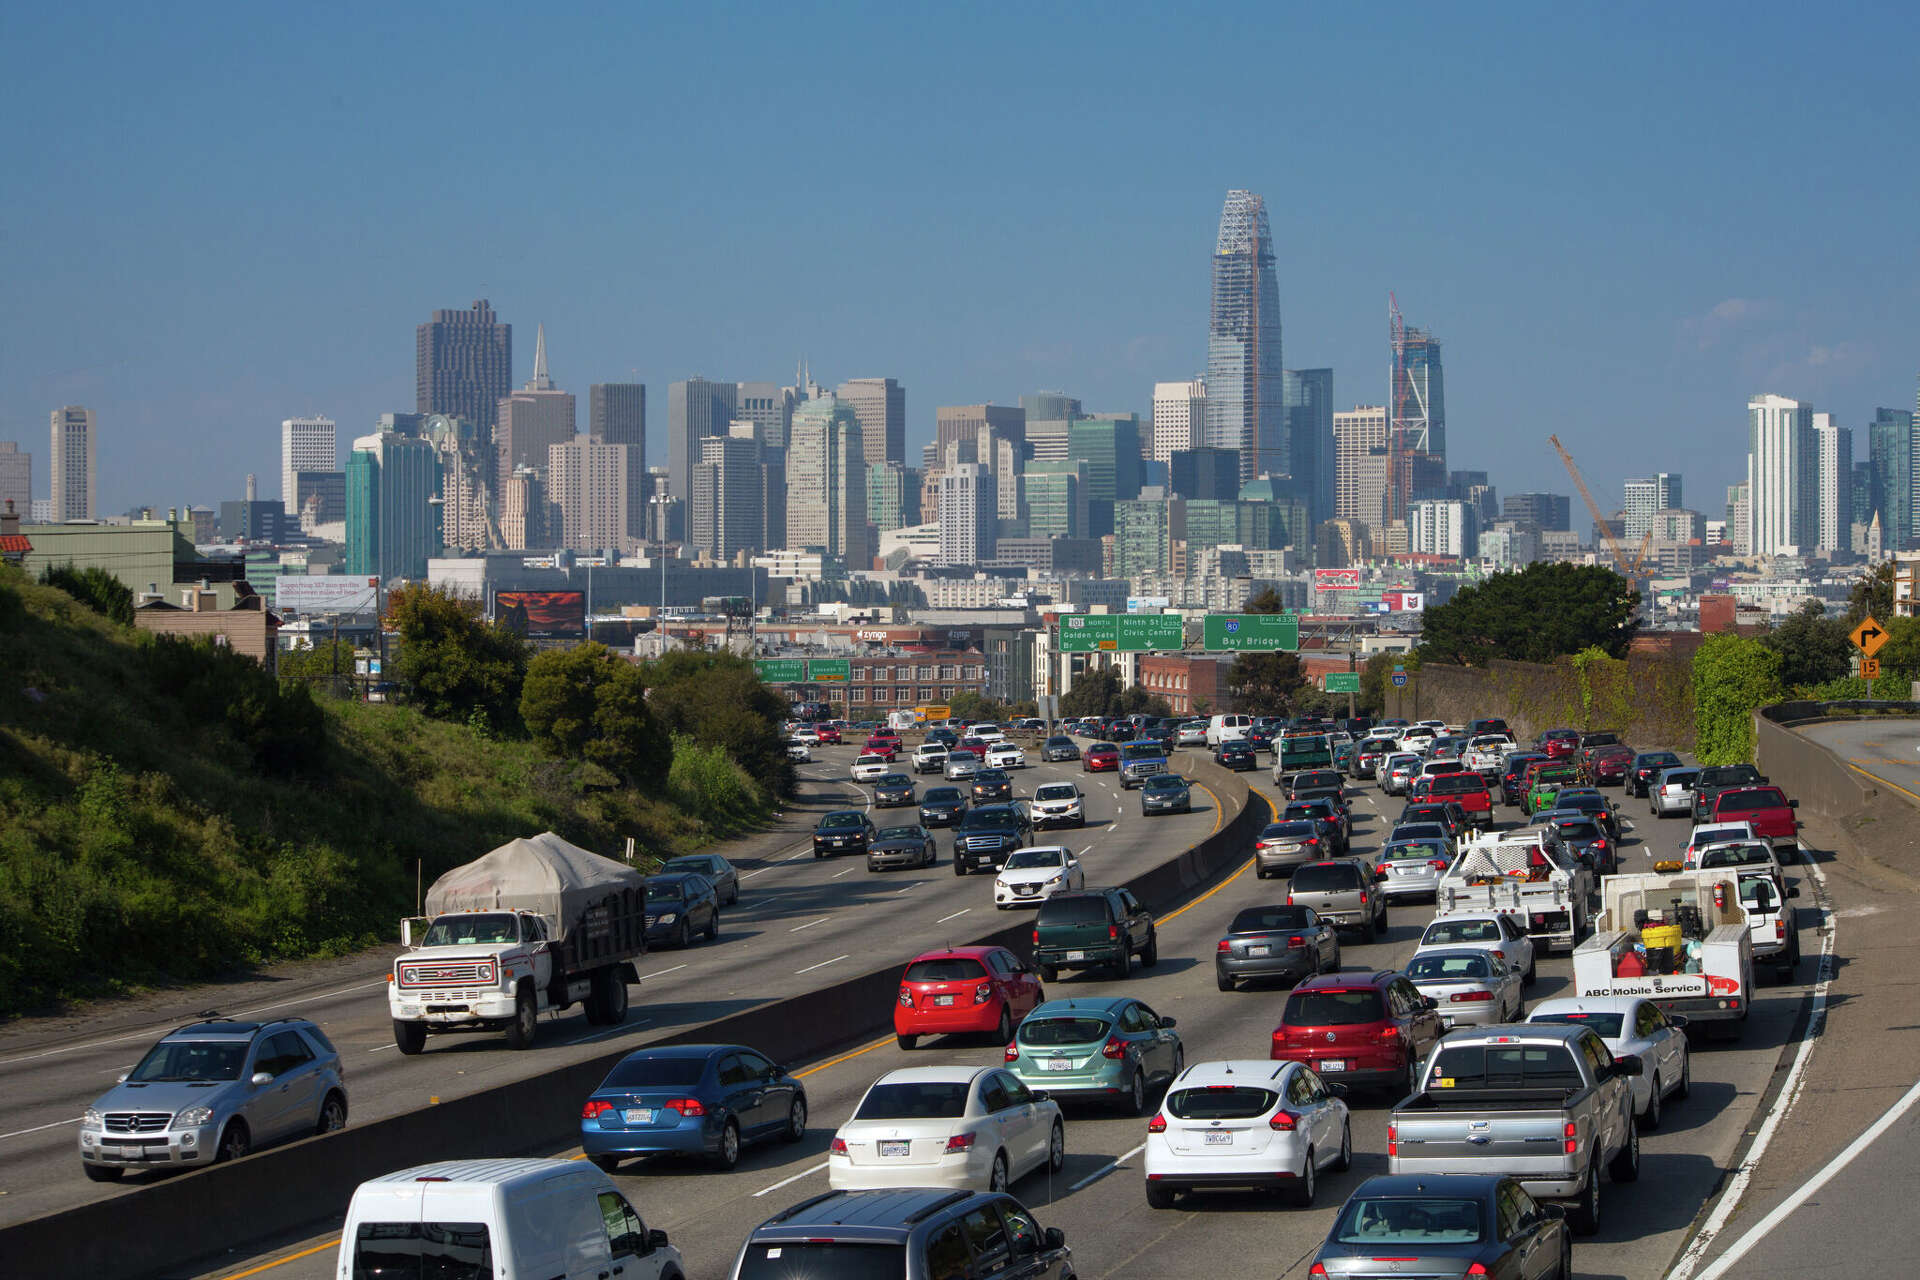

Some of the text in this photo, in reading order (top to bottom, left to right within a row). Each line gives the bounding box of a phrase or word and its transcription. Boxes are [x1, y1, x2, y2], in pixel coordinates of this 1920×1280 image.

[863, 631, 887, 640] zynga
[1063, 641, 1073, 649] Br
[1222, 637, 1280, 646] Bay Bridge
[1863, 662, 1876, 672] 15
[1585, 988, 1610, 997] ABC
[1612, 987, 1652, 996] Mobile
[1655, 984, 1702, 994] Service
